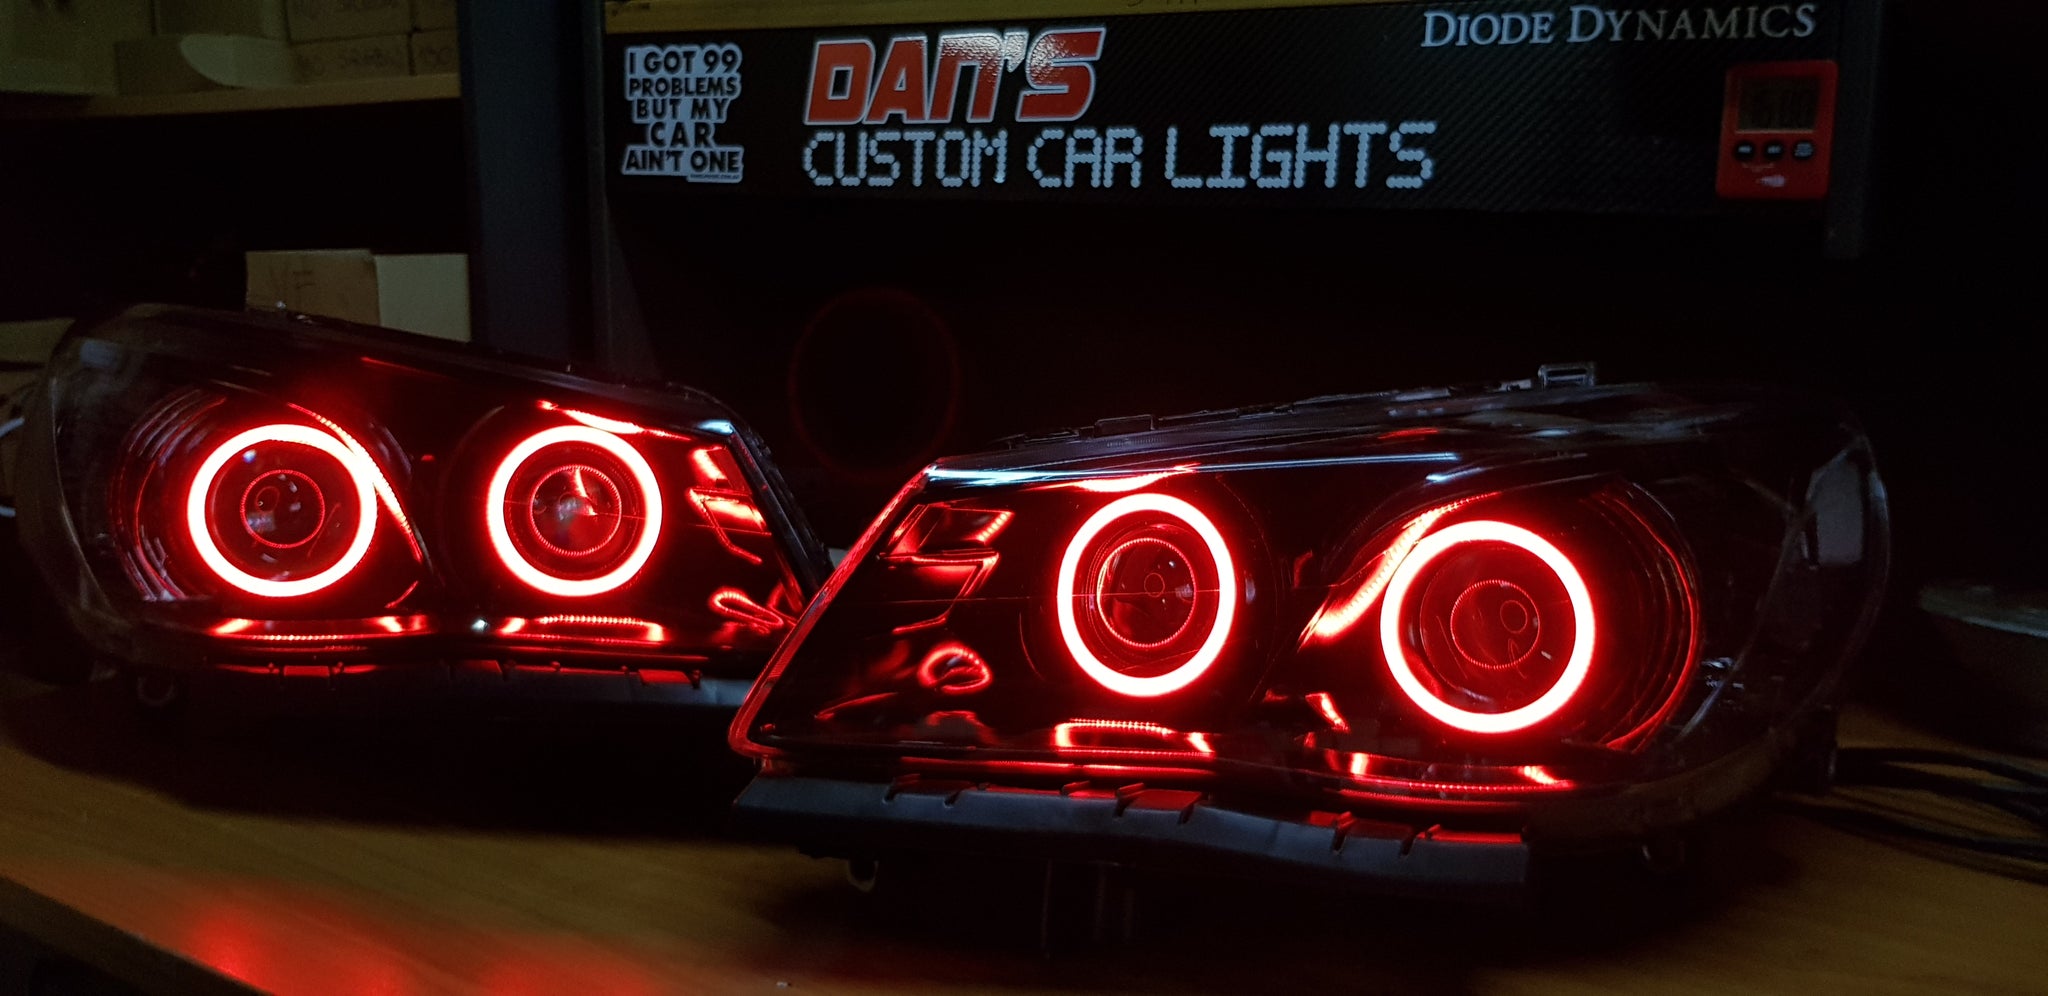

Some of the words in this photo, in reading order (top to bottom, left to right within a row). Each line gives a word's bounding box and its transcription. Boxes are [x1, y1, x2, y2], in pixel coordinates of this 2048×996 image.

[1421, 10, 1554, 48] DIODE
[1566, 4, 1818, 44] DYNAMICS
[629, 52, 635, 75] I
[644, 51, 695, 74] GOT
[704, 50, 737, 74] 99
[629, 77, 737, 97] PROBLEMS
[803, 26, 1106, 126] DAN'S
[637, 98, 682, 119] BUT
[691, 98, 728, 119] MY
[651, 121, 709, 147] CAR
[626, 150, 684, 171] AIN'T
[691, 150, 740, 172] ONE
[802, 128, 1009, 188] CUSTOM
[1027, 126, 1144, 190] CAR
[1164, 120, 1437, 190] LIGHTS
